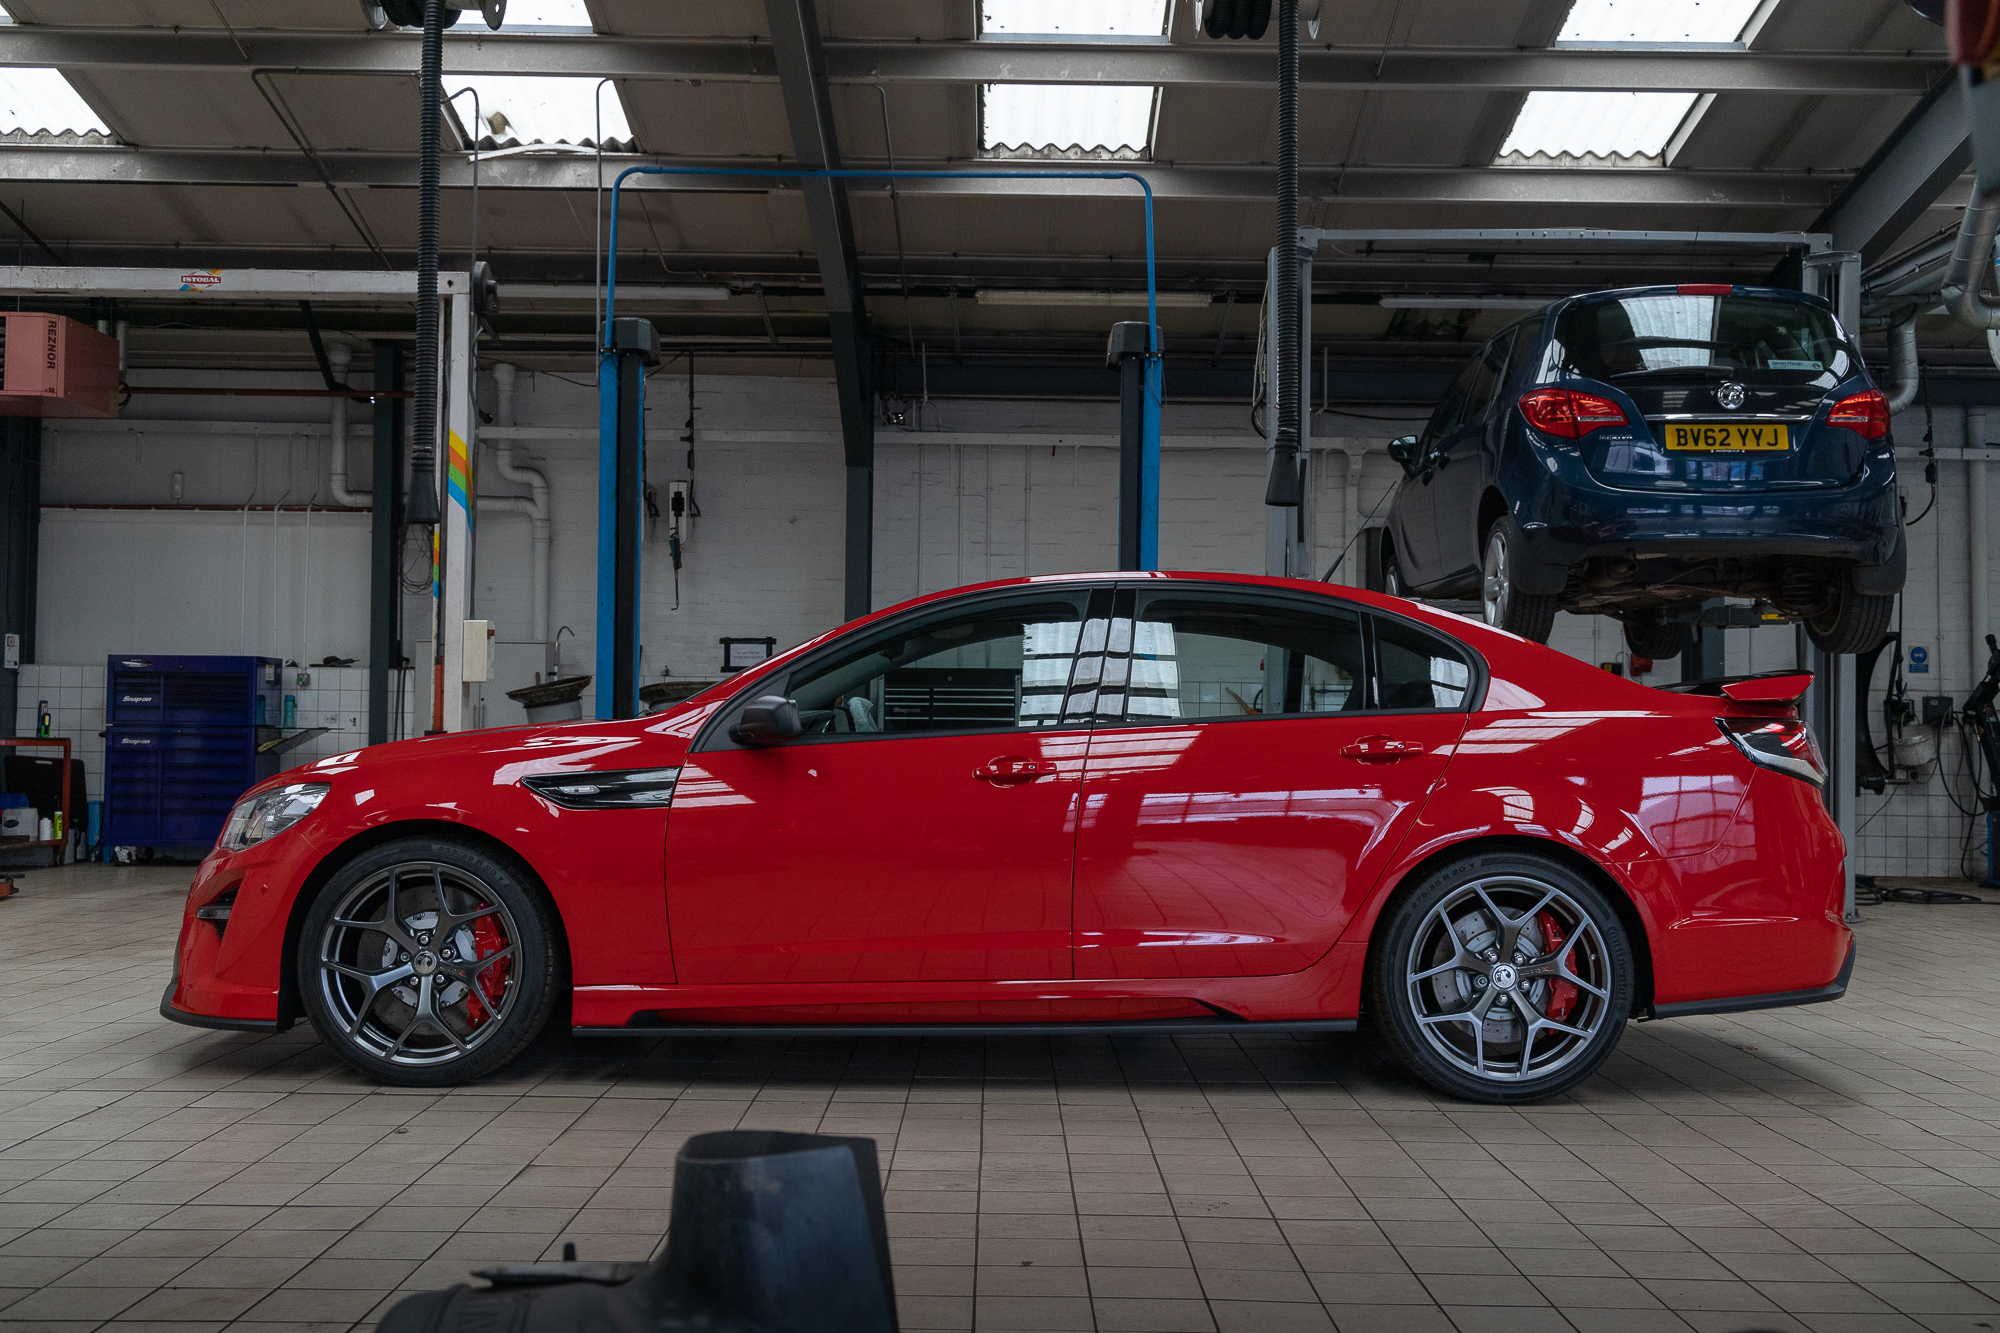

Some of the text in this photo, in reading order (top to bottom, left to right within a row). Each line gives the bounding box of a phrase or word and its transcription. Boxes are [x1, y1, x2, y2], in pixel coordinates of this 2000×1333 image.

[47, 320, 57, 370] REZNOR
[1675, 428, 1779, 447] BV62 YYJ
[123, 695, 152, 703] Snap-on
[437, 846, 476, 862] 255/35
[484, 864, 497, 875] 20
[1411, 879, 1442, 909] 275/35
[1452, 866, 1466, 876] 20
[1607, 926, 1627, 1001] Continental
